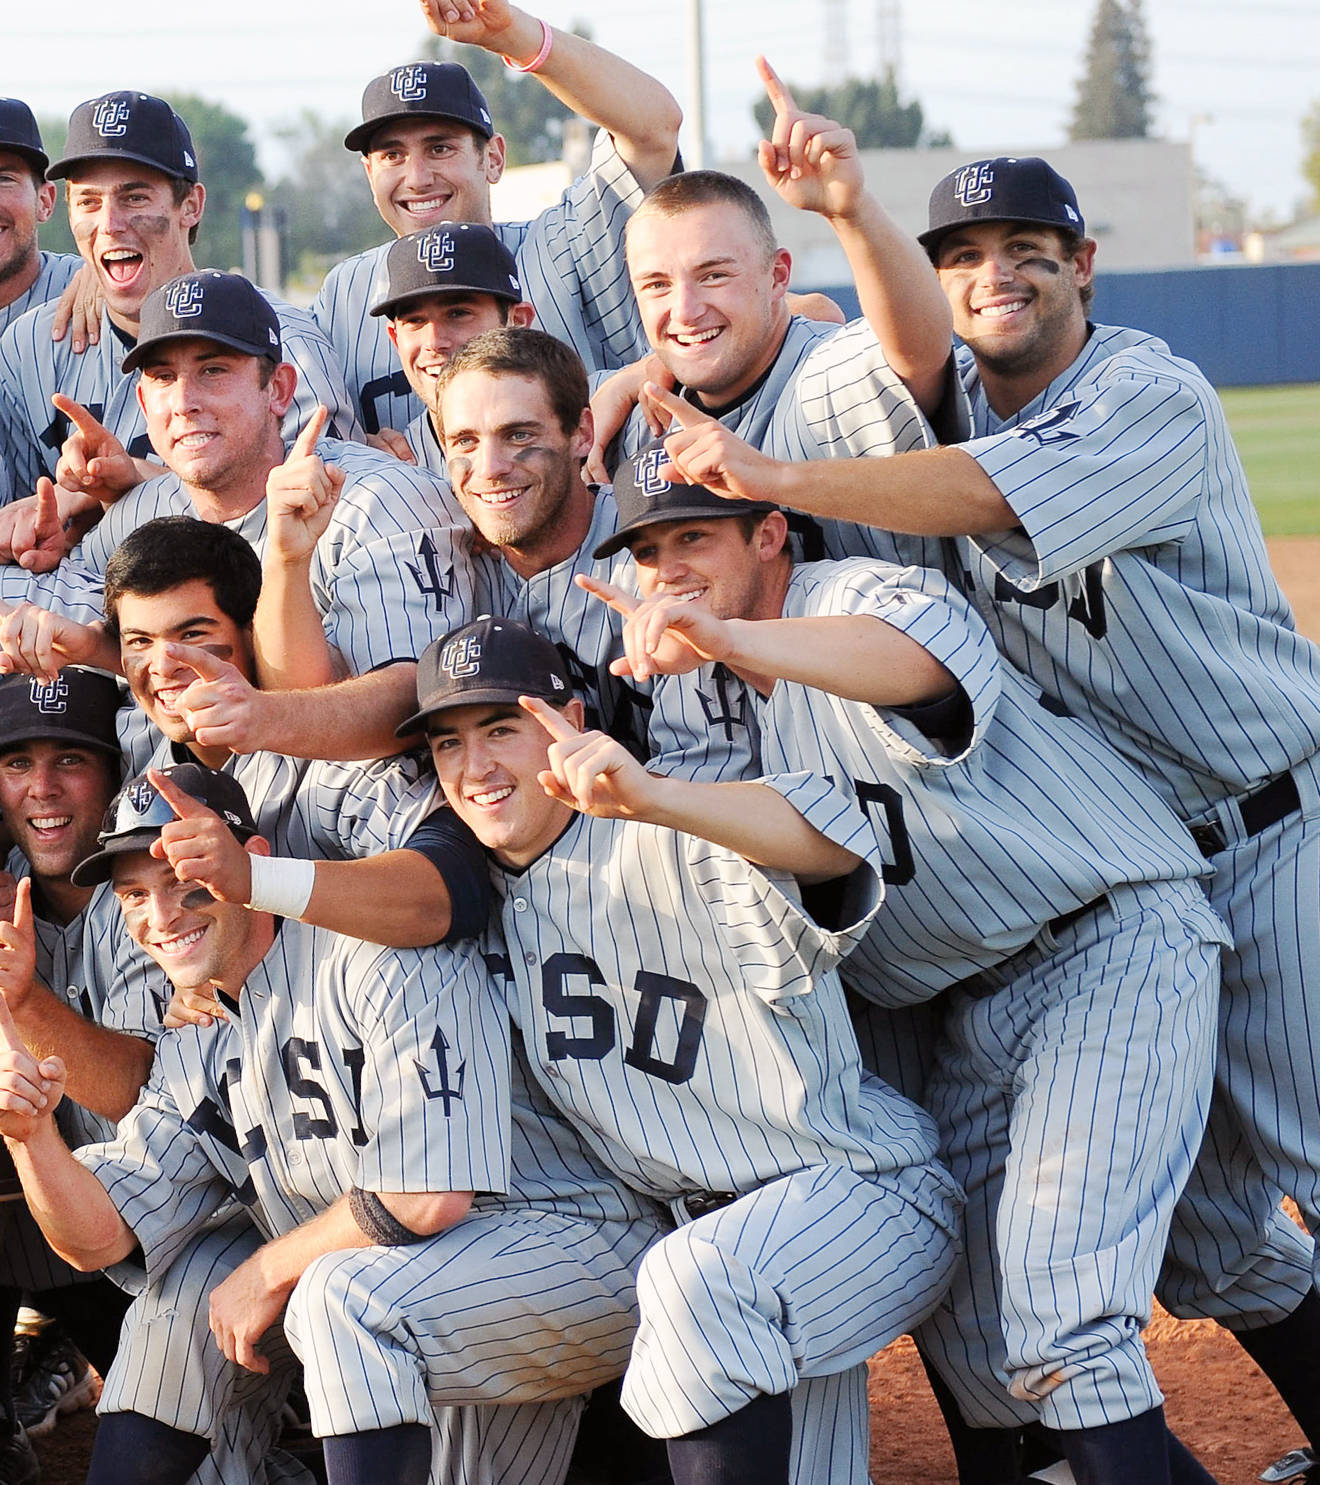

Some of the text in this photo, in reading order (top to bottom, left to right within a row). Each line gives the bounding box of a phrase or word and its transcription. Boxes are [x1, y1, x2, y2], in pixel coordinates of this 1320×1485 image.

[390, 65, 428, 101] UC
[93, 100, 130, 137] UC
[953, 161, 994, 207] UC
[416, 232, 455, 272] UC
[165, 280, 204, 318] UC
[441, 635, 481, 680] UC
